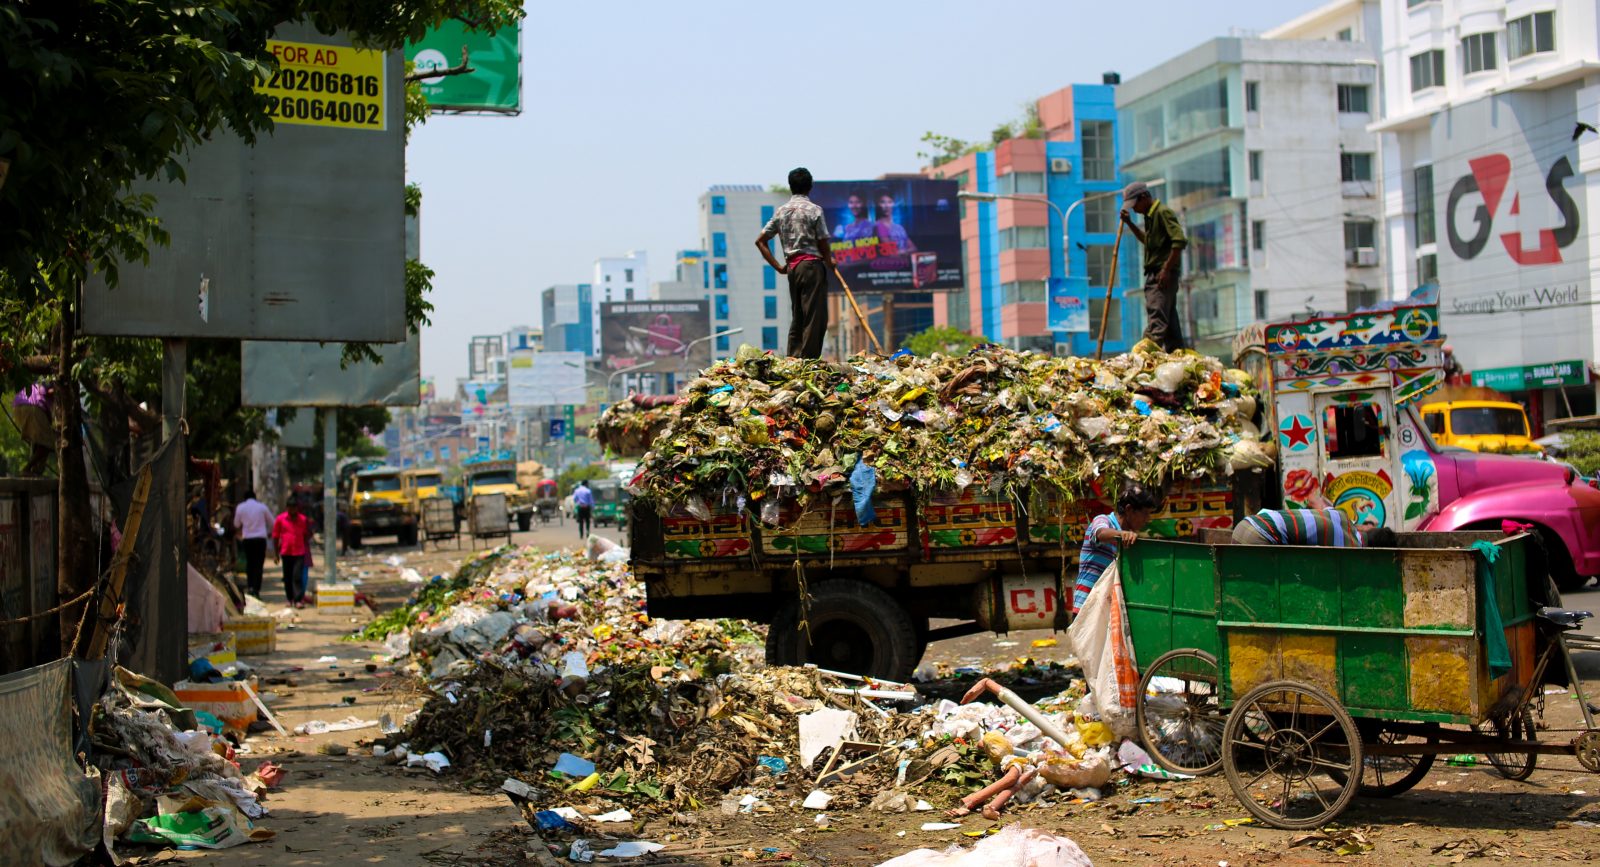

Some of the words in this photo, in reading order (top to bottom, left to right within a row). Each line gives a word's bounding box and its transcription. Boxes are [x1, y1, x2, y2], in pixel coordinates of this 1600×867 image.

[273, 45, 308, 63] FOR
[313, 49, 338, 66] AD
[251, 68, 379, 97] 20206816
[264, 95, 380, 125] 26064002
[1446, 153, 1580, 266] G4S
[1452, 296, 1496, 314] Securing
[1496, 289, 1526, 309] Your
[1533, 284, 1579, 305] World
